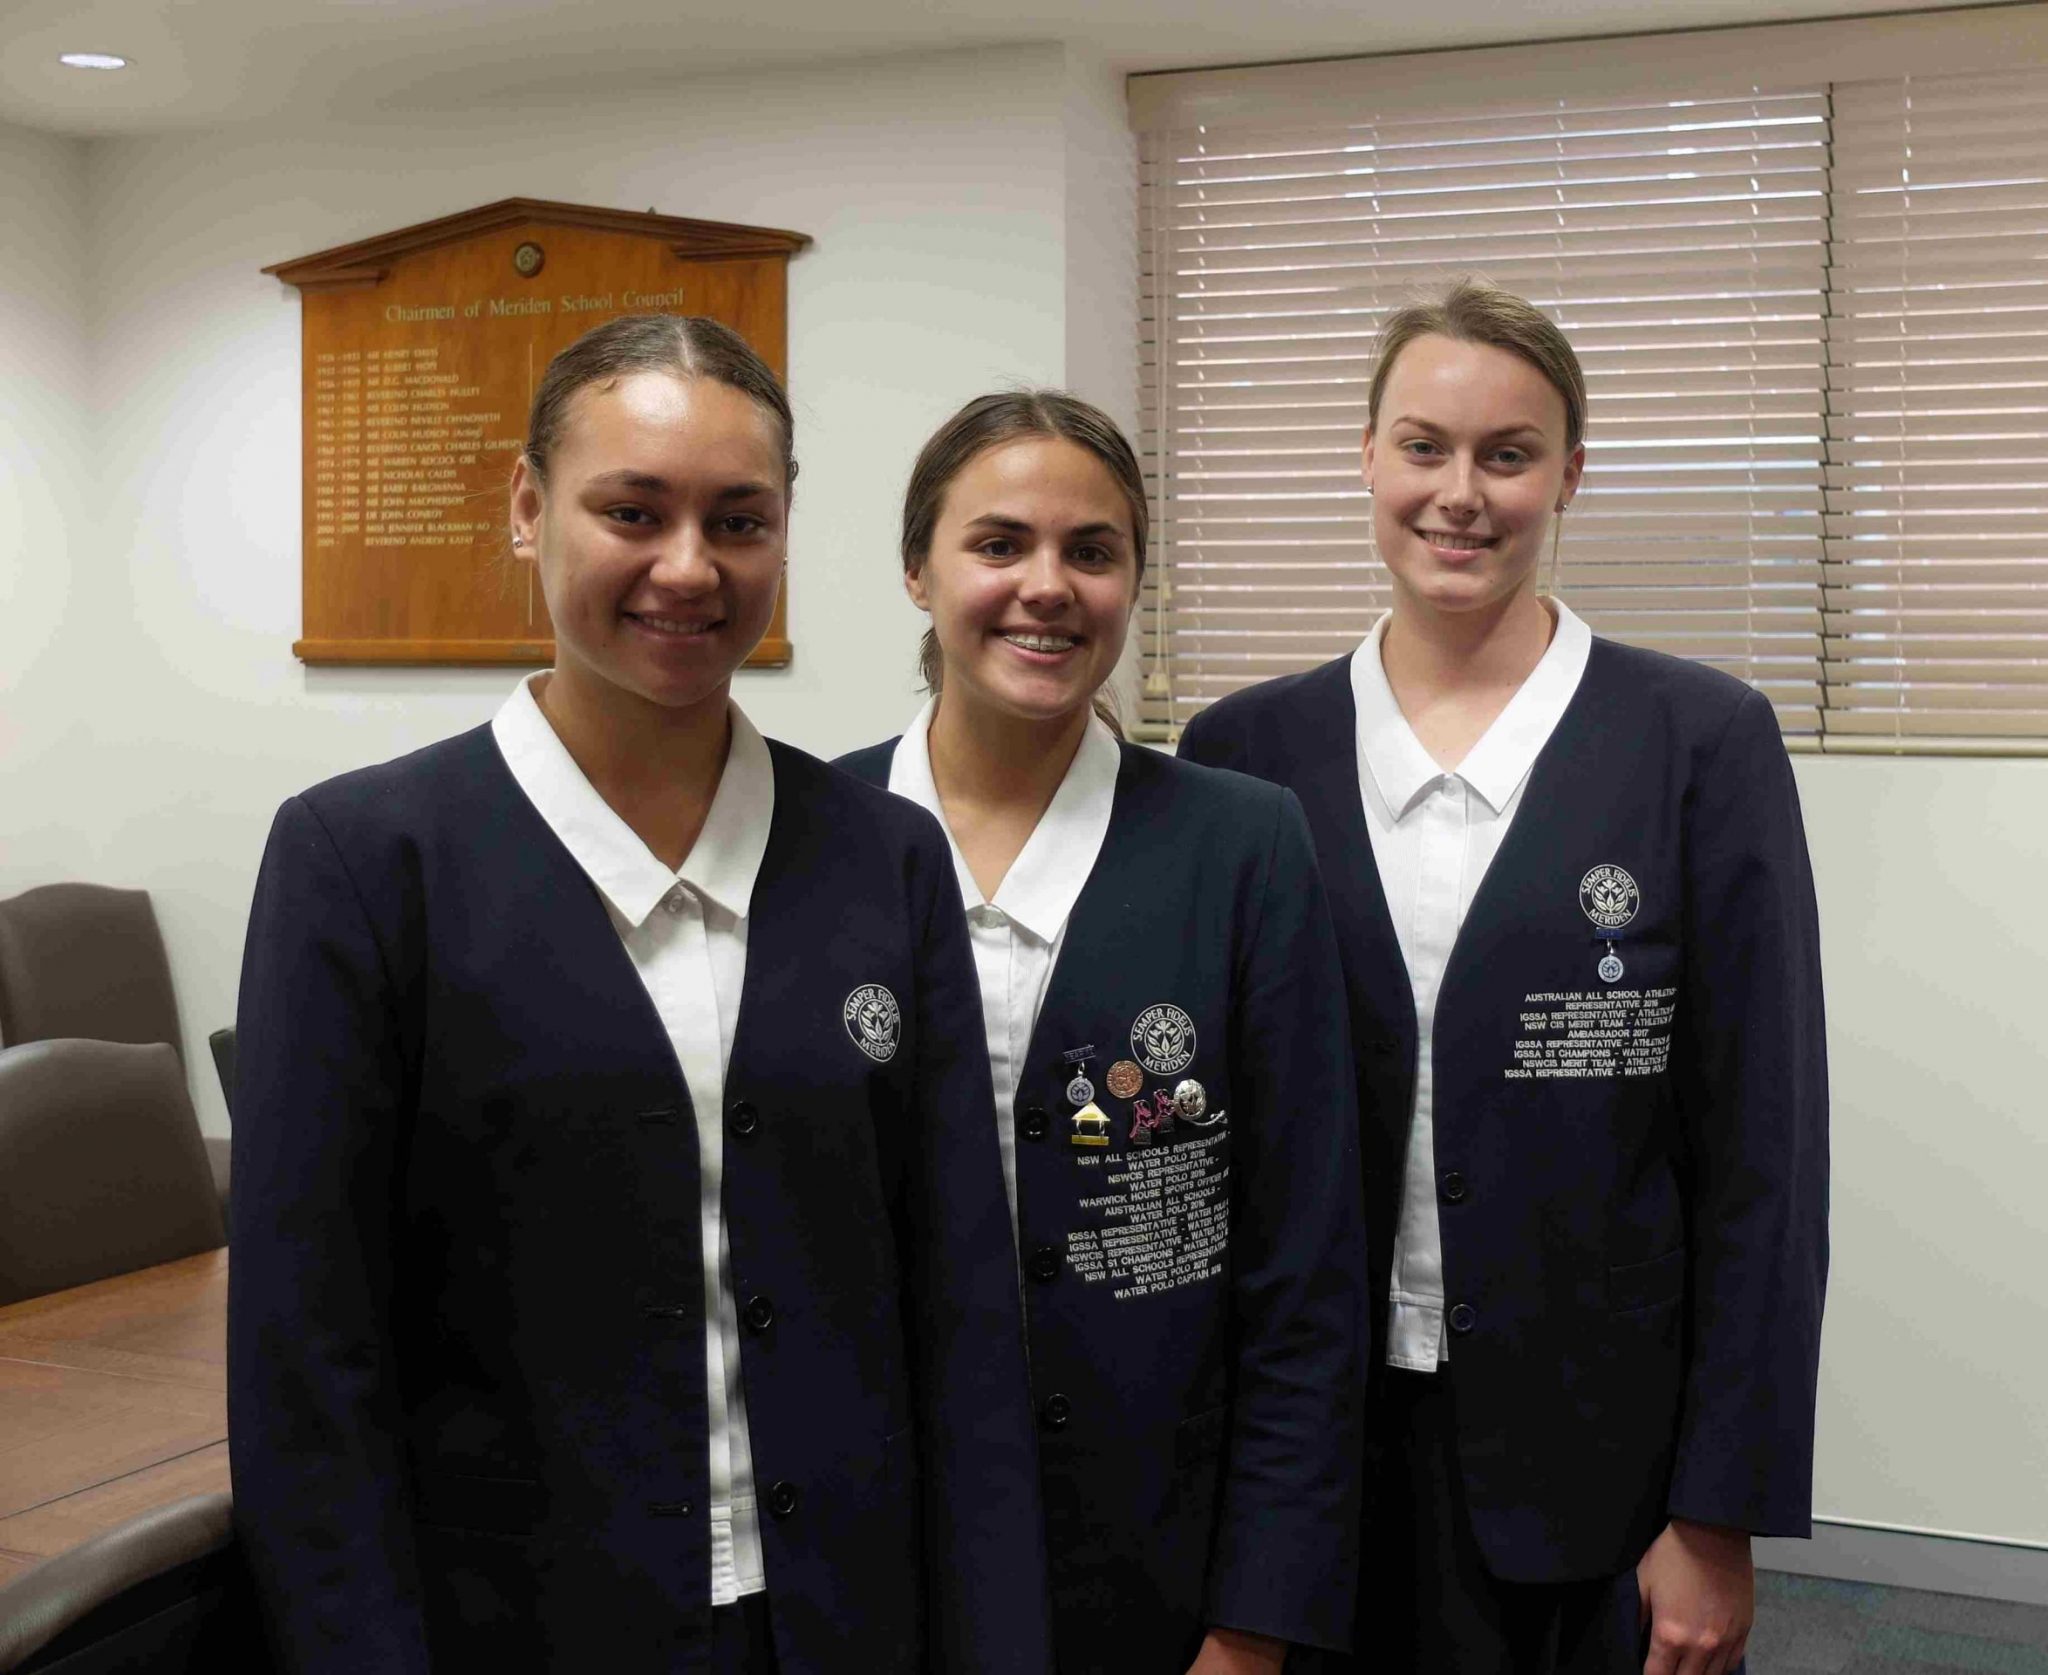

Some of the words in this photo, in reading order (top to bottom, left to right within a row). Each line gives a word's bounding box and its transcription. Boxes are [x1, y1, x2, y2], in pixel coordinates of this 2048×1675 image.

[385, 304, 455, 322] Chairmen
[464, 304, 481, 319] of
[490, 298, 551, 317] Meriden
[561, 292, 613, 313] School
[622, 288, 684, 306] Council
[1581, 867, 1611, 895] SEMPER
[1613, 868, 1637, 898] FIDELIS
[1588, 908, 1632, 925] MERIDEN
[846, 988, 876, 1021] SEMPER
[1525, 992, 1582, 1002] AUSTRALIAN
[1586, 991, 1603, 1000] ALL
[1607, 990, 1642, 999] SCHOOL
[1565, 1000, 1640, 1010] REPRESENTATIVE
[1133, 1007, 1164, 1041] SEMPER
[1166, 1008, 1193, 1037] FIDELIS
[1520, 1012, 1547, 1022] IGSSA
[1551, 1009, 1627, 1020] REPRESENTATIVE
[1525, 1021, 1546, 1031] NSW
[1550, 1020, 1565, 1029] CIS
[1568, 1020, 1594, 1029] MERIT
[1599, 1019, 1623, 1028] TEAM
[1515, 1040, 1543, 1049] IGSSA
[1546, 1039, 1622, 1048] REPRESENTATIVE
[1567, 1029, 1629, 1039] AMBASSADOR
[1633, 1029, 1649, 1038] 2017
[860, 1037, 896, 1058] MERIDEN
[1514, 1050, 1541, 1059] IGSSA
[1545, 1049, 1555, 1058] S1
[1558, 1048, 1611, 1058] CHAMPIONS
[1622, 1048, 1649, 1057] WATER
[1143, 1050, 1191, 1072] MERIDEN
[1523, 1059, 1558, 1068] NSWCIS
[1561, 1059, 1587, 1068] MERIT
[1591, 1059, 1616, 1068] TEAM
[1504, 1068, 1533, 1078] IGSSA
[1536, 1068, 1614, 1077] REPRESENTATIVE
[1624, 1066, 1651, 1076] WATER
[1077, 1155, 1100, 1166] NSW
[1105, 1153, 1122, 1163] ALL
[1126, 1146, 1169, 1161] SCHOOLS
[1128, 1158, 1161, 1171] WATER
[1164, 1152, 1187, 1165] POLO
[1107, 1171, 1144, 1184] NSWCIS
[1147, 1156, 1214, 1178] REPRESENTATIVE
[1129, 1178, 1162, 1192] WATER
[1165, 1172, 1187, 1185] POLO
[1079, 1194, 1128, 1208] WARWICK
[1130, 1188, 1161, 1201] HOUSE
[1164, 1180, 1194, 1195] SPORTS
[1104, 1199, 1162, 1216] AUSTRALIAN
[1166, 1195, 1180, 1207] ALL
[1183, 1186, 1215, 1202] SCHOOLS
[1130, 1209, 1163, 1223] WATER
[1166, 1203, 1188, 1216] POLO
[1067, 1230, 1098, 1242] IGSSA
[1100, 1217, 1177, 1238] REPRESENTATIVE
[1187, 1206, 1211, 1221] WATER
[1069, 1241, 1099, 1252] IGSSA
[1102, 1226, 1178, 1248] REPRESENTATIVE
[1188, 1217, 1212, 1231] WATER
[1066, 1250, 1104, 1263] NSWCIS
[1107, 1235, 1182, 1258] REPRESENTATIVE
[1191, 1226, 1215, 1240] WATER
[1075, 1260, 1104, 1272] IGSSA
[1107, 1258, 1118, 1268] S1
[1121, 1247, 1173, 1266] CHAMPIONS
[1183, 1238, 1209, 1252] WATER
[1085, 1271, 1106, 1282] NSW
[1111, 1267, 1129, 1278] ALL
[1132, 1258, 1174, 1274] SCHOOLS
[1136, 1270, 1168, 1285] WATER
[1170, 1264, 1191, 1277] POLO
[1114, 1285, 1148, 1299] WATER
[1151, 1279, 1174, 1293] POLO
[1177, 1269, 1209, 1285] CAPTAIN
